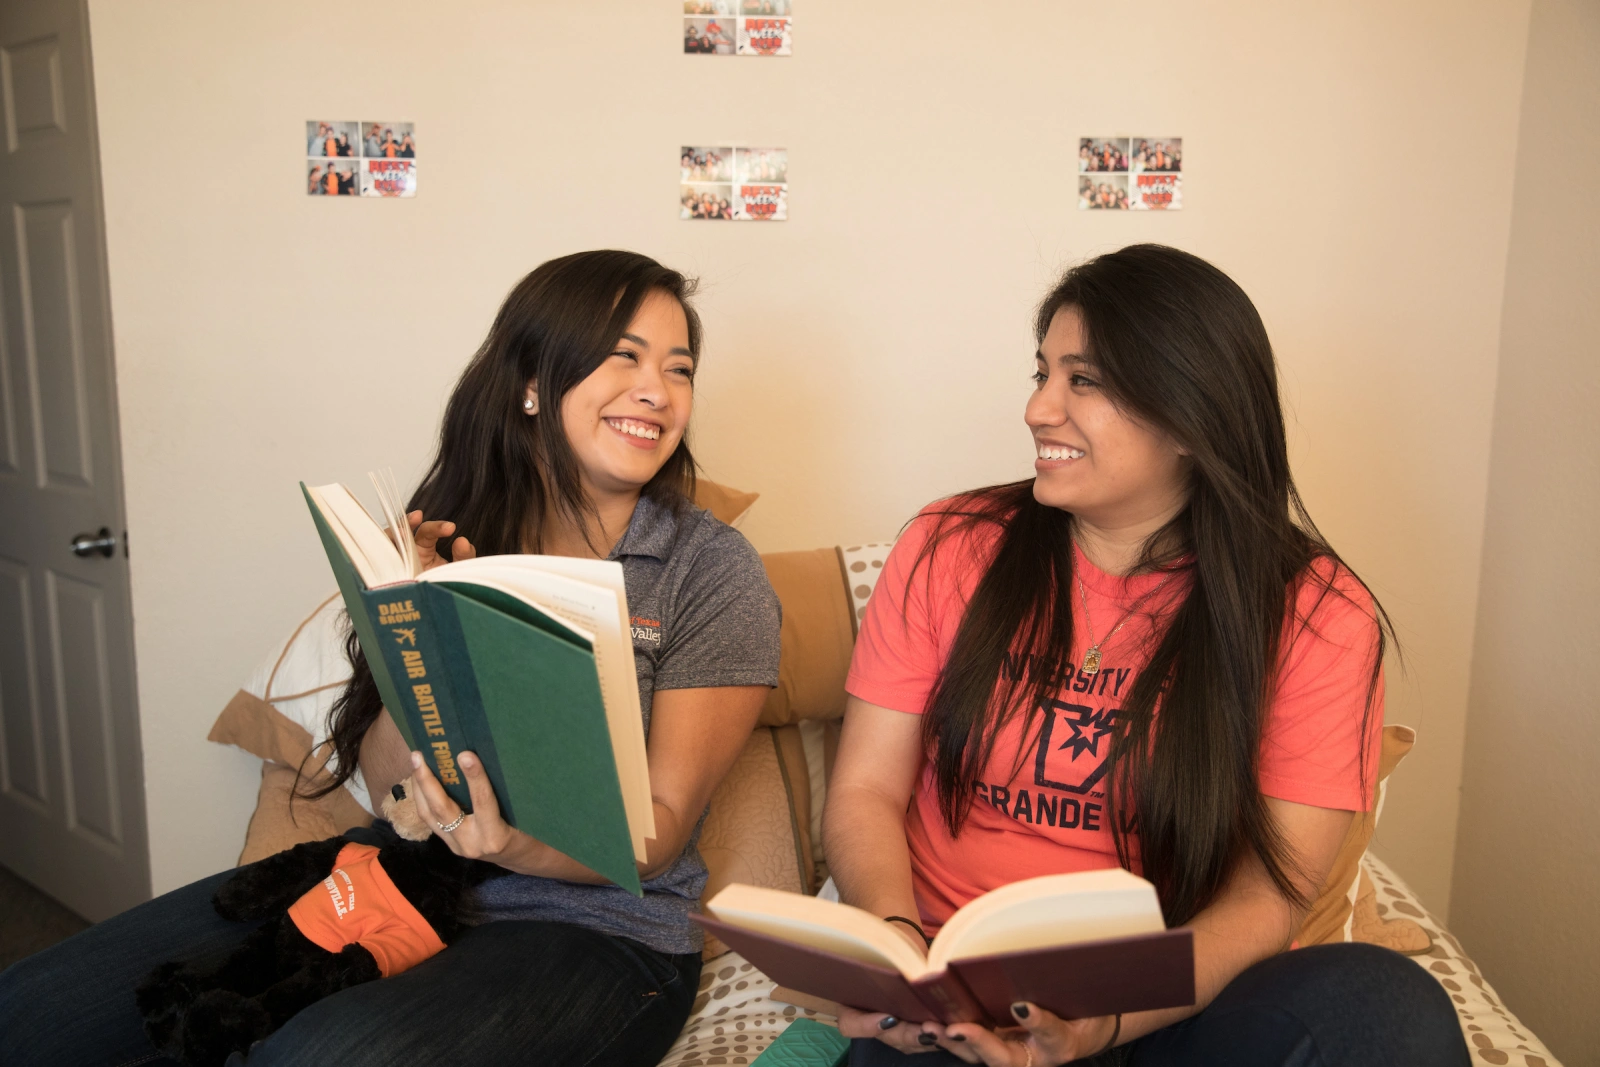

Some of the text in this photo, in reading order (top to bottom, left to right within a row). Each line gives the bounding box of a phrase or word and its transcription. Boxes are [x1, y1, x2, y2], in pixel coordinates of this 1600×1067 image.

[378, 600, 415, 616] DALE
[378, 610, 421, 625] BROWN
[401, 650, 460, 786] AIR BATTLE FORCE
[971, 780, 1103, 831] GRANDE
